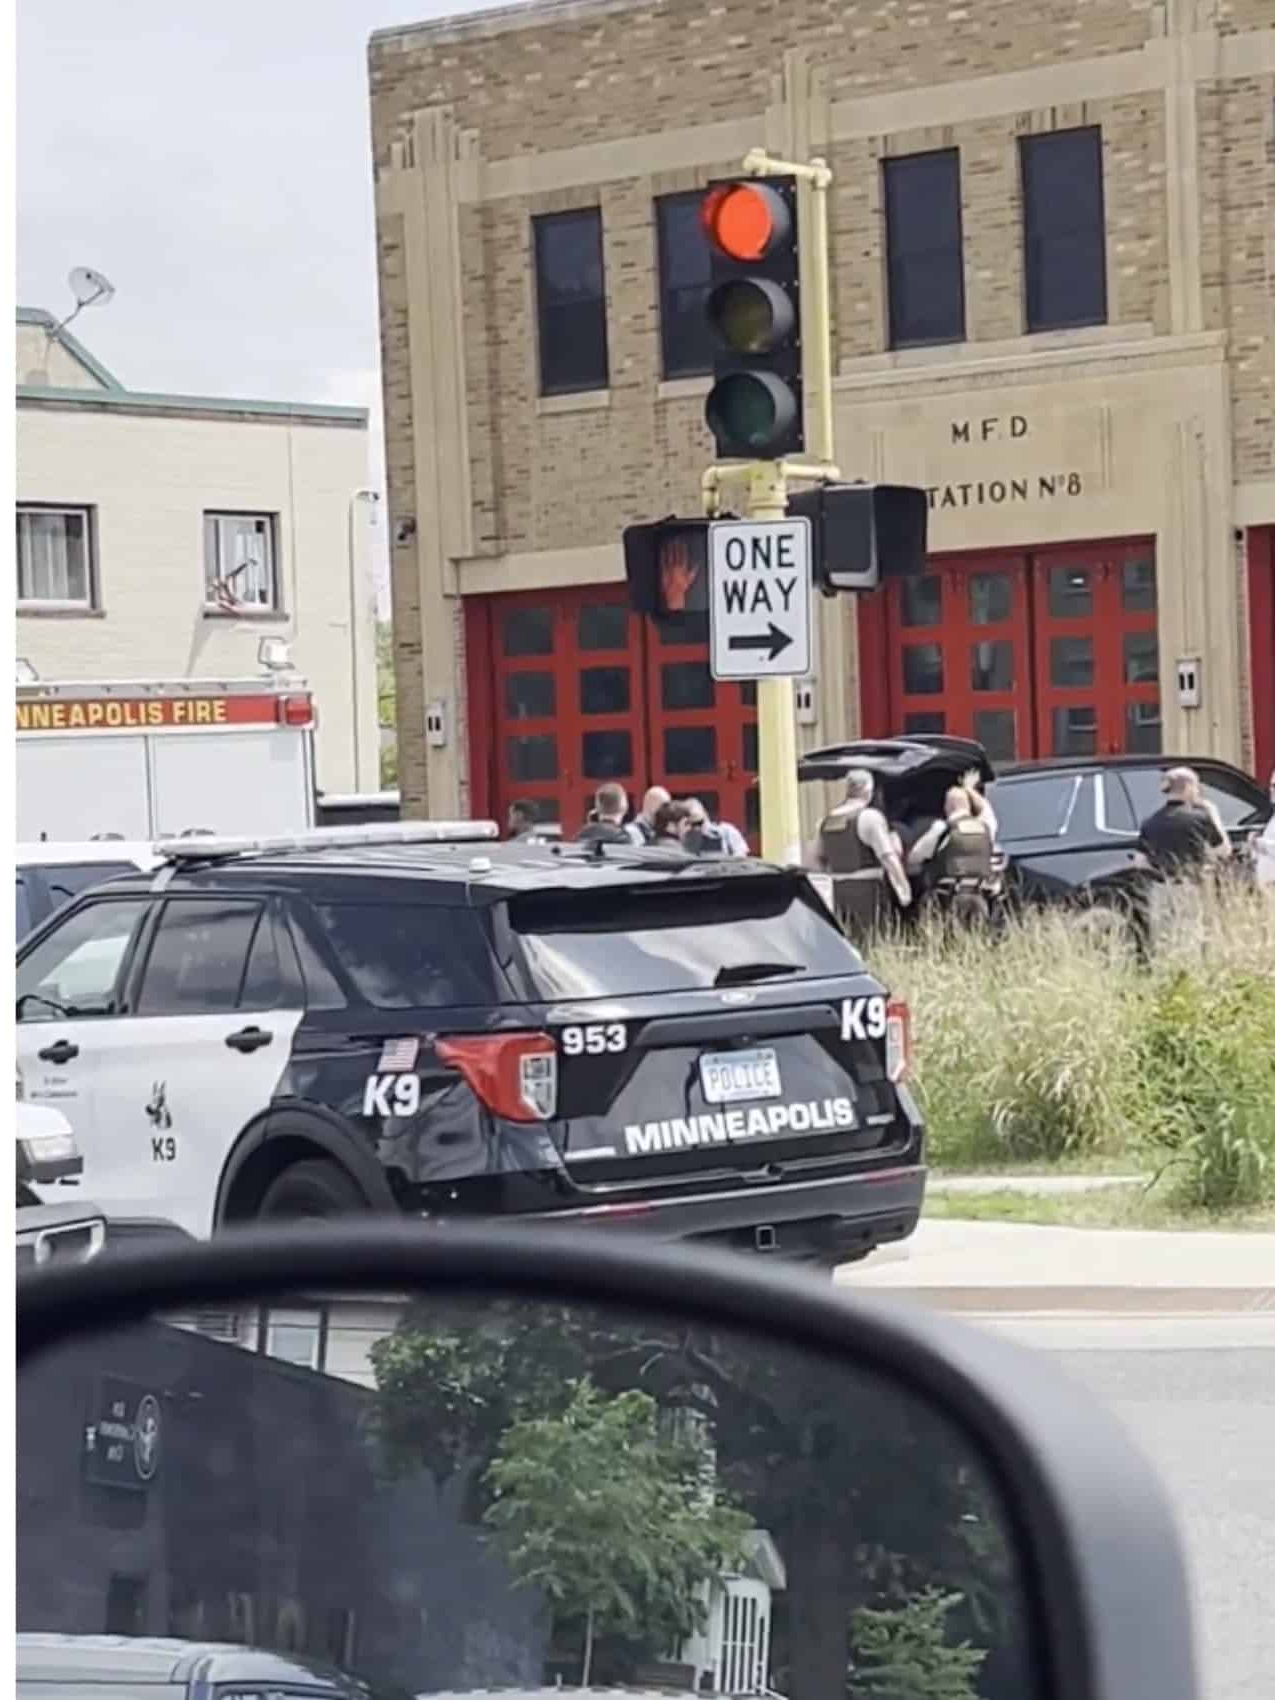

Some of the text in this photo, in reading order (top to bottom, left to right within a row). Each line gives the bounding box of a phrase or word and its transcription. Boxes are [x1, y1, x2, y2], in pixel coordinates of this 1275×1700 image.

[926, 478, 1028, 508] TATION
[725, 535, 795, 571] ONE
[723, 577, 798, 615] WAY
[173, 701, 226, 723] FIRE
[840, 997, 886, 1041] K9
[562, 1024, 627, 1055] 953
[709, 1062, 775, 1091] POLICE
[363, 1074, 421, 1117] K9
[625, 1097, 854, 1154] MINNEAPOLIS
[151, 1137, 177, 1162] K9
